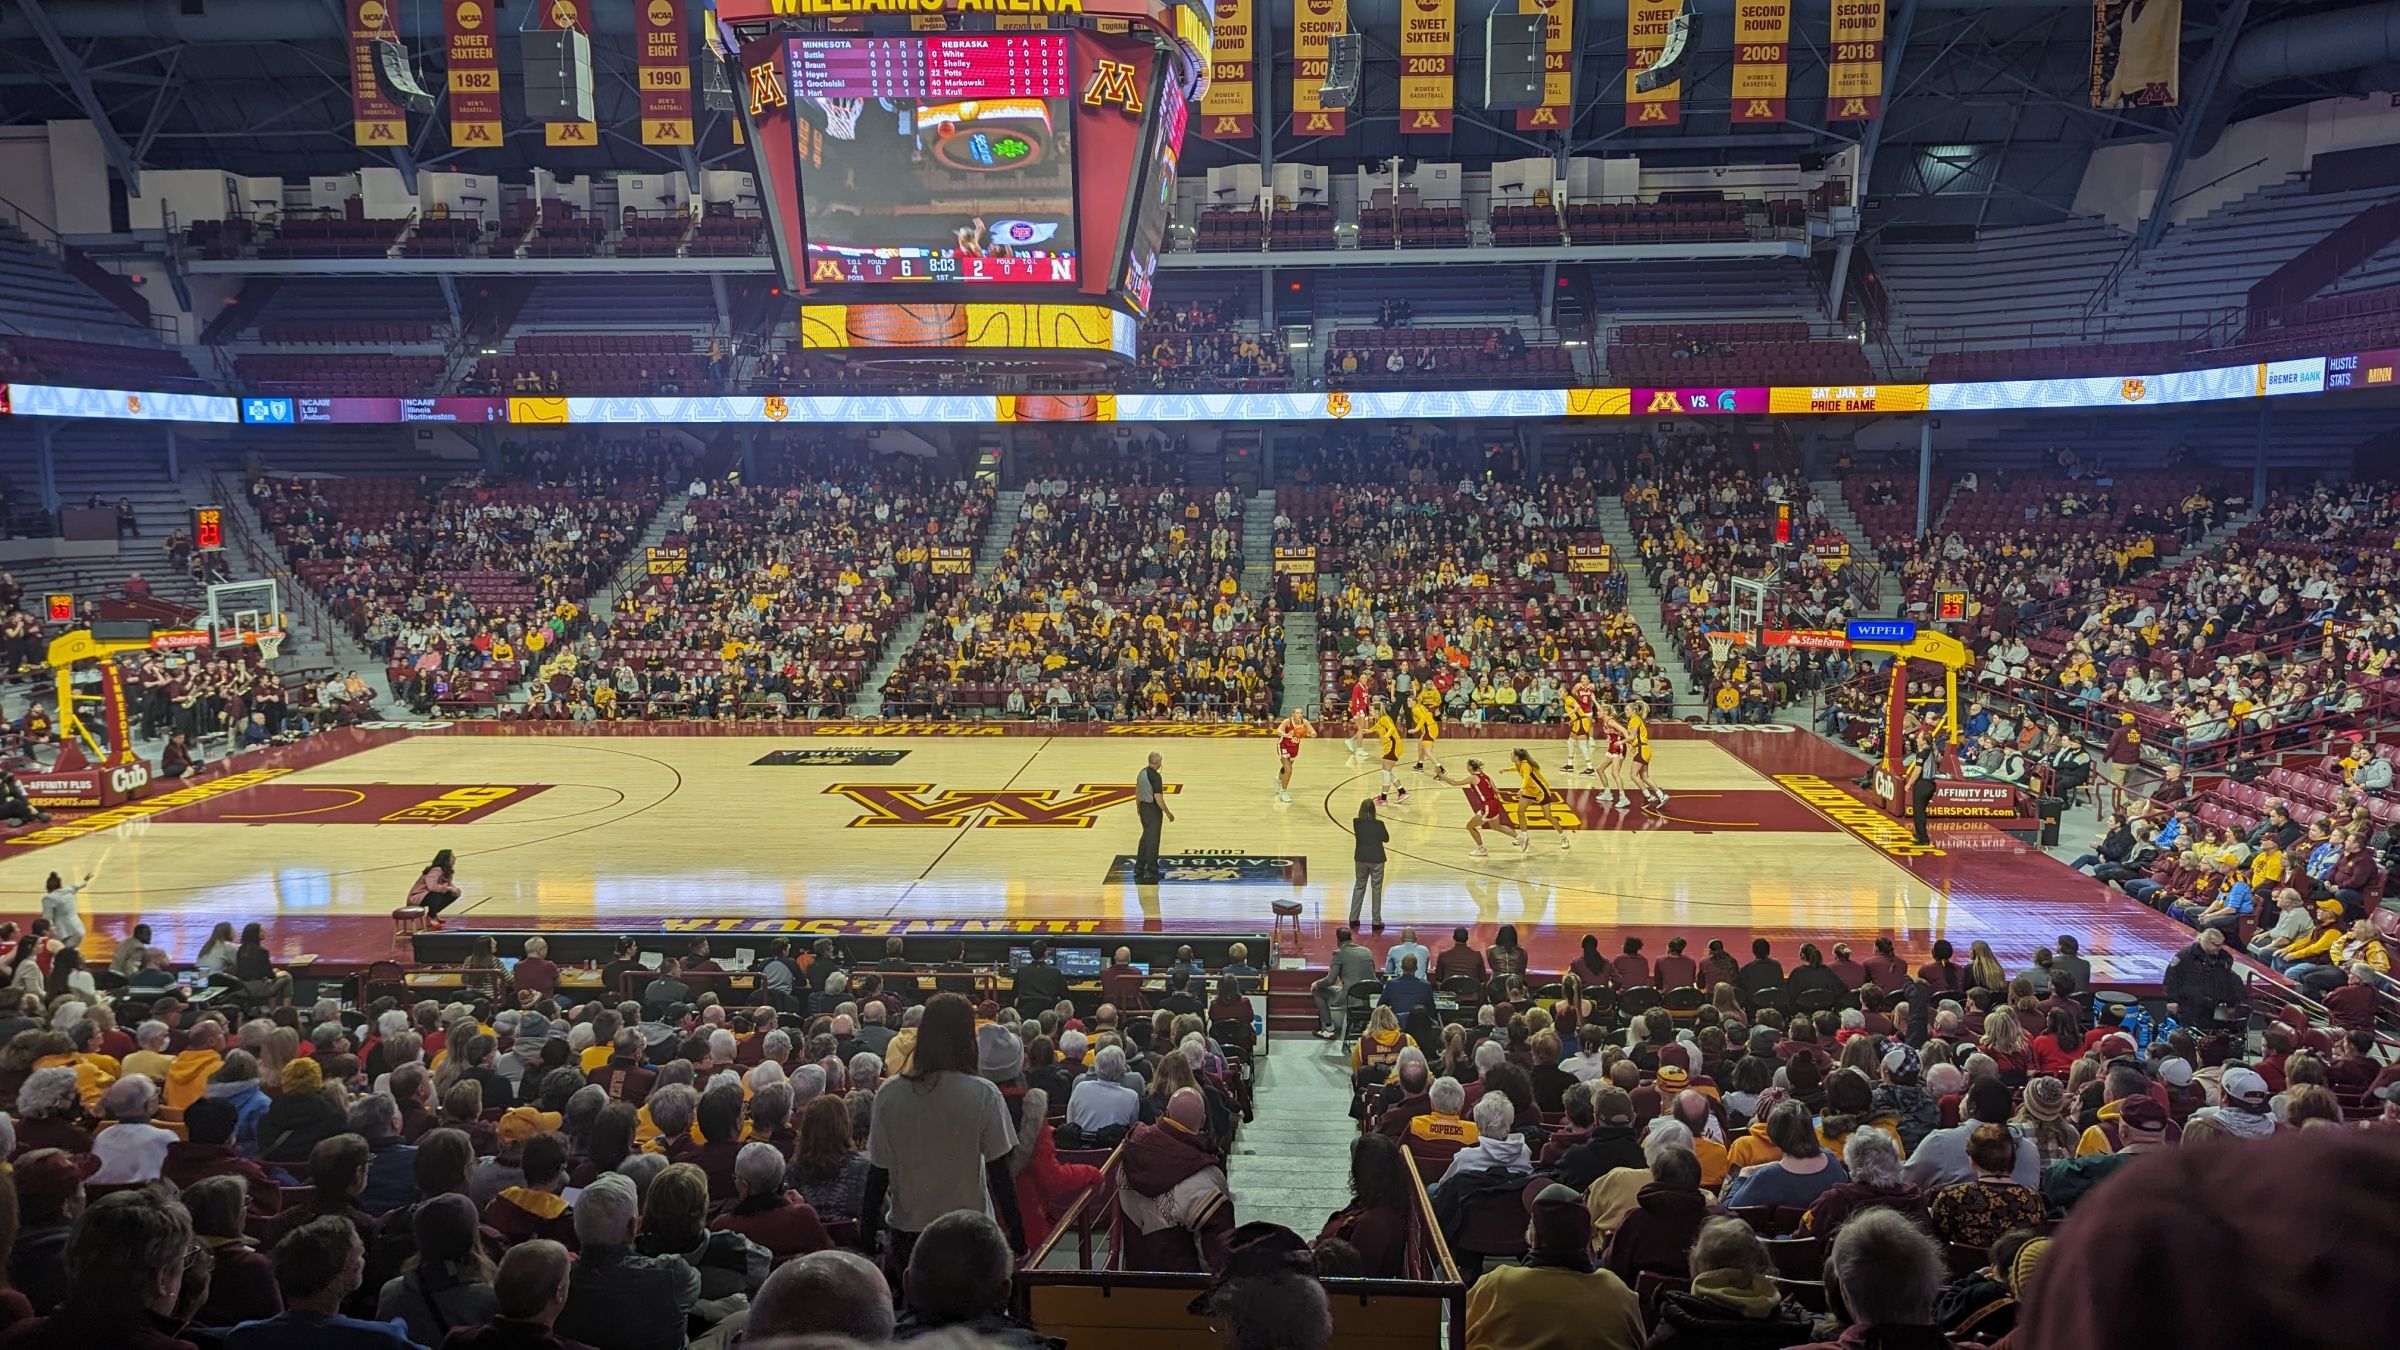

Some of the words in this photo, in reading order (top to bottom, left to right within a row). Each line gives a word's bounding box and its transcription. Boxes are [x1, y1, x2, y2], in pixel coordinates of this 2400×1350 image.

[769, 0, 944, 14] WILLIAMS
[957, 0, 1083, 13] ARENA
[1741, 5, 1785, 17] SECOND
[1837, 3, 1880, 16] SECOND
[460, 14, 481, 22] NCAA
[1637, 9, 1676, 21] SWEET
[1299, 22, 1342, 33] SECOND
[1410, 19, 1446, 30] SWEET
[1633, 23, 1668, 35] SIXTEE
[1744, 19, 1782, 31] ROUND
[1839, 17, 1876, 30] ROUND
[1213, 25, 1247, 36] ECOND
[453, 35, 489, 46] SWEET
[648, 32, 676, 44] ELITE
[1406, 32, 1450, 43] SIXTEEN
[802, 41, 852, 49] MINNESOTA
[1212, 38, 1245, 50] OUND
[451, 48, 493, 59] SIXTEEN
[648, 45, 678, 57] EIGHT
[793, 51, 799, 59] 3
[803, 51, 825, 59] Battle
[931, 50, 938, 58] 0
[942, 50, 965, 58] White
[1742, 46, 1780, 61] 2009
[1837, 44, 1875, 60] 2018
[791, 60, 802, 68] 10
[805, 61, 826, 69] Braun
[943, 59, 971, 68] Shelley
[1302, 61, 1328, 76] 200
[1408, 58, 1446, 73] 2003
[792, 70, 803, 78] 24
[931, 69, 940, 77] 22
[943, 69, 962, 77] Potts
[1212, 64, 1245, 79] 1994
[456, 74, 491, 88] 1982
[647, 71, 681, 85] 1990
[793, 80, 803, 88] 25
[931, 79, 941, 87] 40
[944, 79, 985, 87] Markowski
[794, 89, 804, 97] 52
[807, 89, 823, 97] Hart
[945, 88, 963, 96] Krull
[851, 265, 858, 274] 4
[875, 265, 881, 275] 0
[901, 260, 911, 276] 6
[929, 259, 955, 271] 8:03
[973, 260, 983, 277] 2
[1004, 264, 1010, 275] 0
[1027, 264, 1033, 274] 4
[1051, 259, 1072, 280] N
[2329, 356, 2358, 370] HUSTLE
[2268, 373, 2298, 385] BREMER
[2299, 371, 2321, 382] BANK
[2329, 372, 2351, 387] STATS
[2367, 367, 2393, 383] MINN
[1811, 388, 1830, 399] SAT.
[1836, 387, 1859, 398] JAN.
[1862, 385, 1876, 397] 20
[301, 399, 331, 407] NCAAW
[1690, 394, 1709, 407] VS.
[1811, 400, 1841, 411] PRIDE
[302, 406, 318, 414] LSU
[302, 413, 331, 421] Auburn
[406, 413, 456, 421] Northwestern
[199, 524, 219, 546] 23
[1944, 594, 1965, 604] 8:02
[51, 606, 70, 619] 23
[1942, 604, 1959, 617] 23
[1857, 626, 1905, 636] WIPFLI
[108, 664, 130, 748] MINNESOTA
[815, 726, 1005, 735] WILLIAMS
[1692, 723, 1795, 734] Cub
[111, 764, 148, 793] Cub
[30, 780, 71, 790] AFFINITY
[71, 780, 92, 790] PLUS
[1772, 774, 1866, 807] GOLDEN
[1875, 770, 1895, 801] Cub
[1937, 787, 1982, 798] AFFINITY
[1983, 788, 2008, 798] PLUS
[27, 796, 100, 807] ERSPORTS.com
[1905, 806, 2014, 818] GHERSPORTS.com
[661, 919, 1102, 936] MINNESOTA
[1430, 1124, 1464, 1136] GOPHERS
